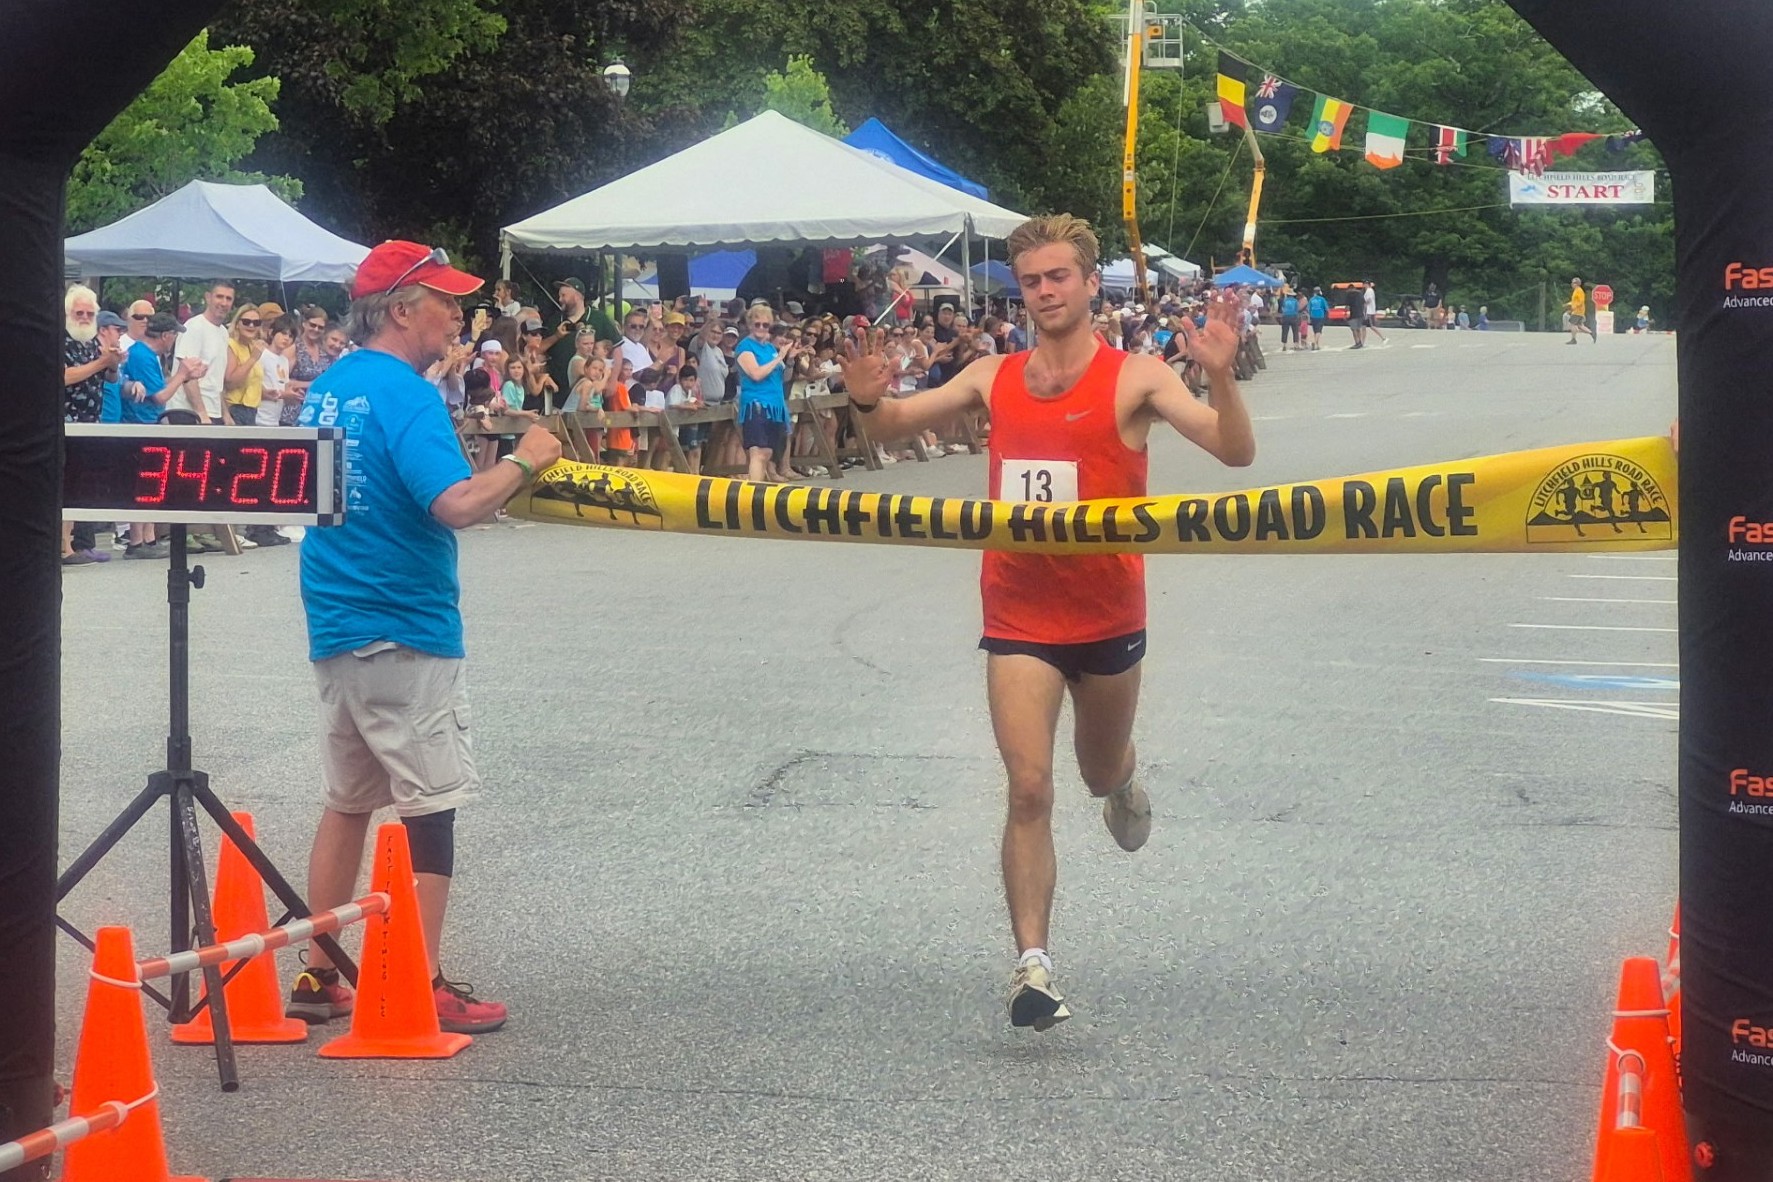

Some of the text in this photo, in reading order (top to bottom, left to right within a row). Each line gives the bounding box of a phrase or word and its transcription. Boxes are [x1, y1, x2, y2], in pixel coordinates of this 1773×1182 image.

[1547, 185, 1625, 199] START
[1594, 291, 1612, 300] STOP
[135, 446, 310, 504] 34:20
[1020, 469, 1053, 503] 13
[1534, 456, 1663, 507] LITCHFIELD HILLS ROAD RACE
[696, 473, 1478, 543] LITCHFIELD HILLS ROAD RACE
